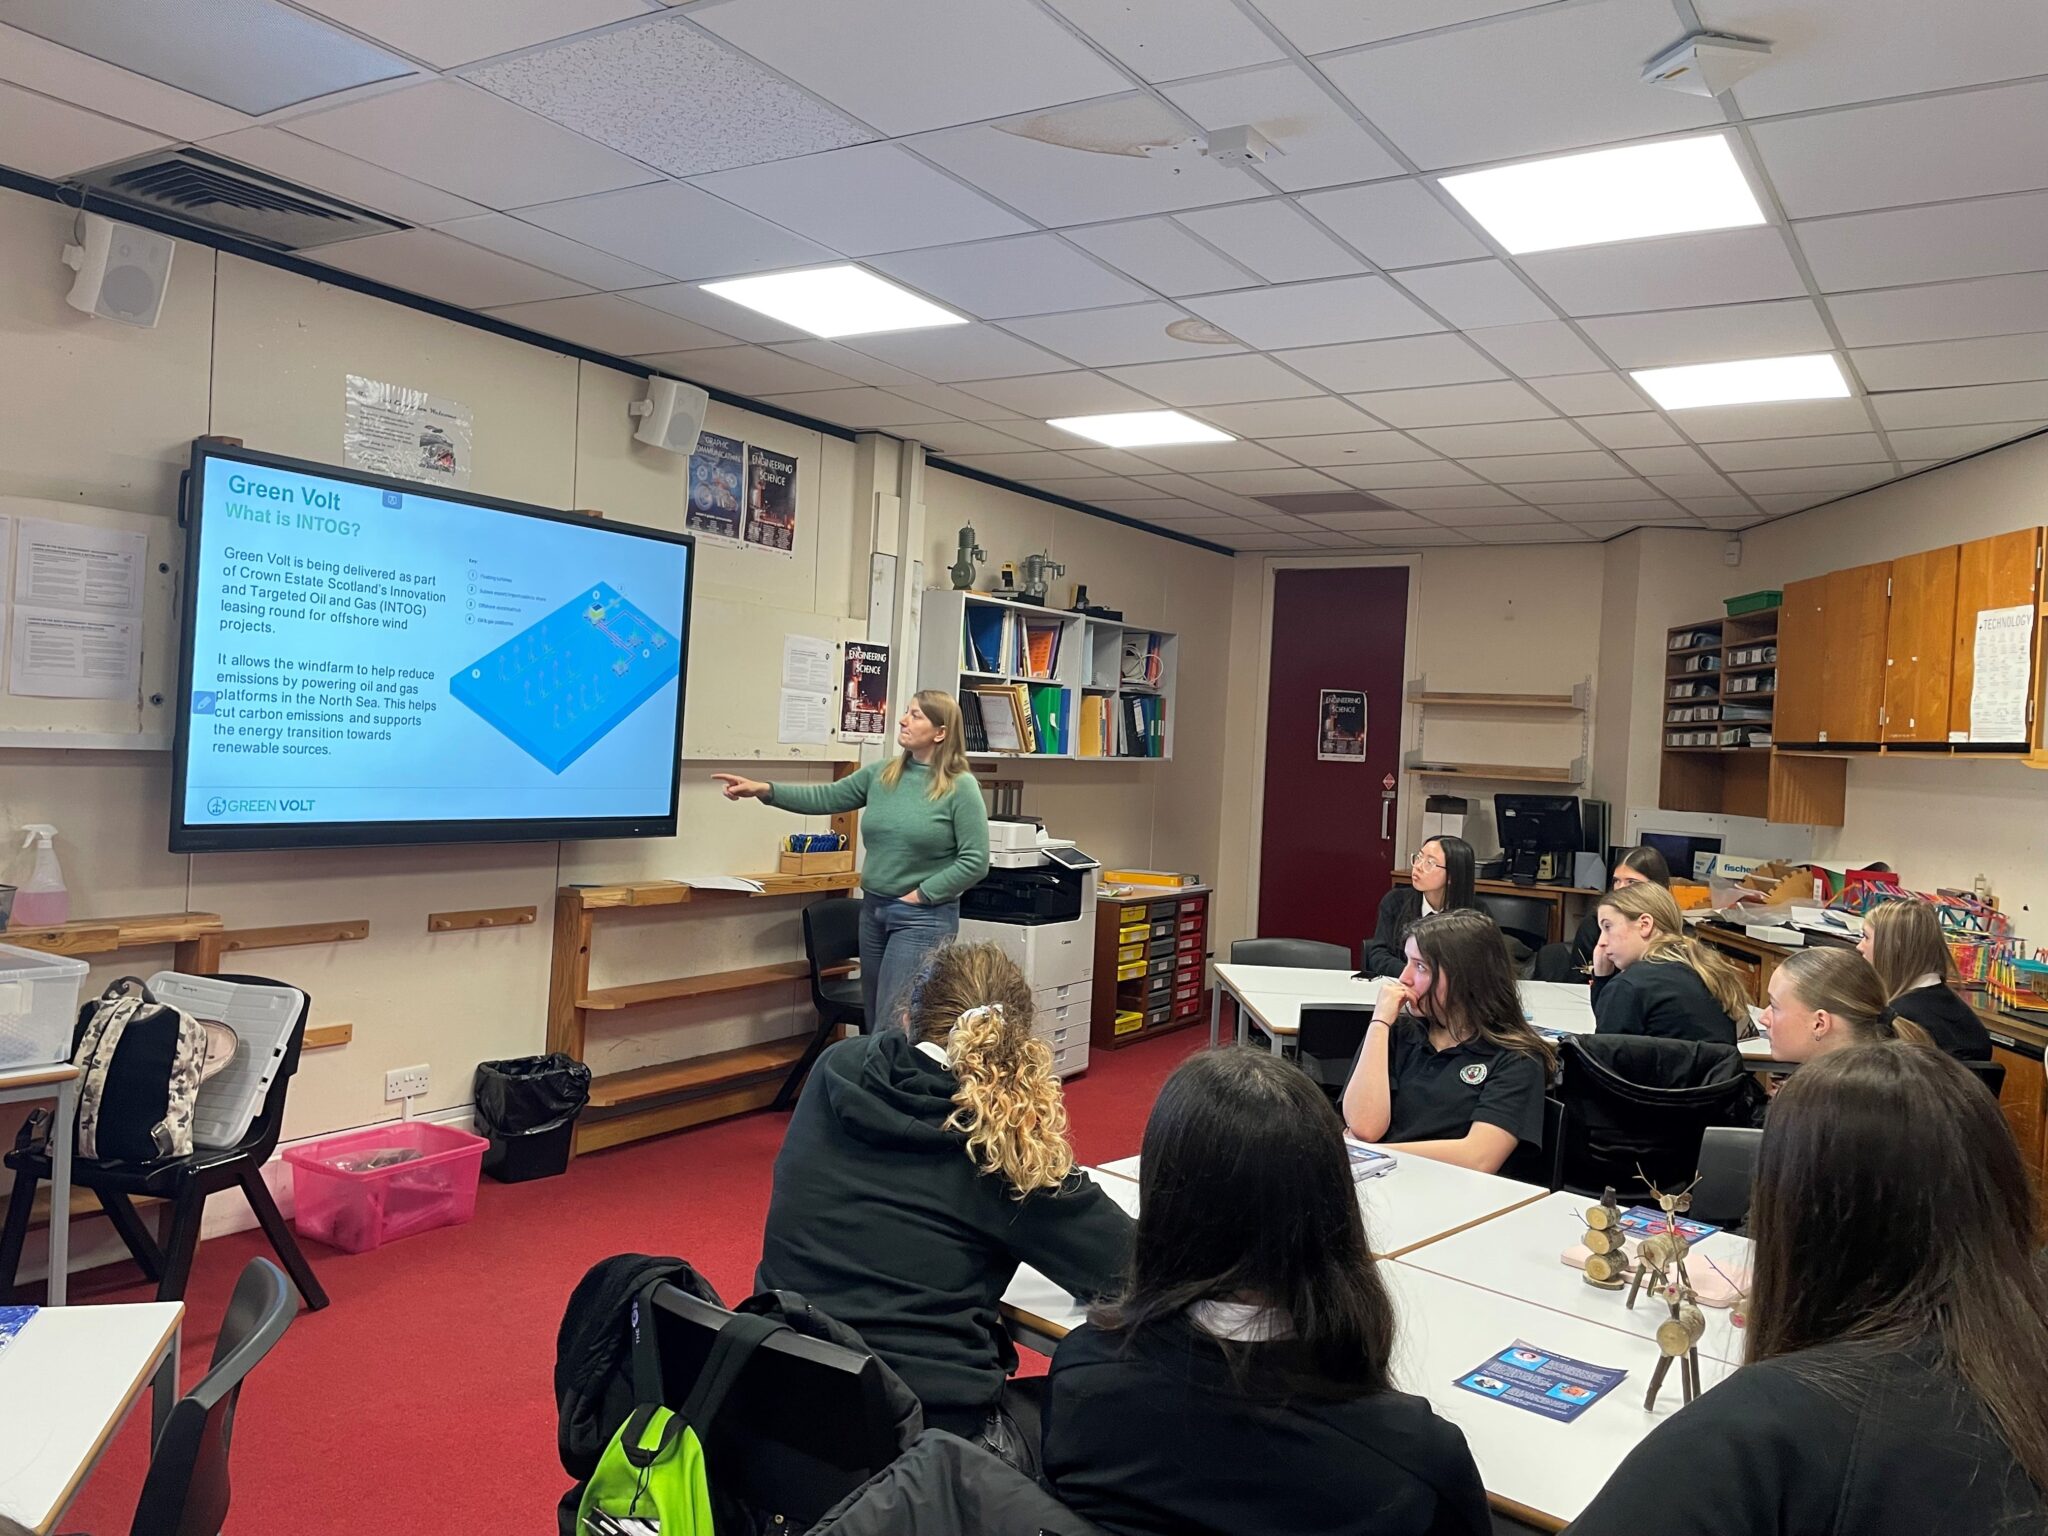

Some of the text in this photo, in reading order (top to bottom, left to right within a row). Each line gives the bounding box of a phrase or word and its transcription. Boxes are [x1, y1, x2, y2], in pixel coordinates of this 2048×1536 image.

[705, 436, 729, 449] GRAPHIC
[696, 444, 742, 462] OMMUNICATION
[752, 454, 793, 473] ENGINEERING
[760, 471, 786, 486] SCIENCE
[228, 474, 341, 511] Green Volt
[225, 502, 361, 537] What is INTOG?
[224, 546, 436, 587] Green Volt is being delivered as part
[222, 565, 446, 602] of Crown Estate Scotland's Innovation
[221, 582, 427, 618] and Targeted Oil and Gas (INTOG)
[220, 599, 408, 630] leasing round for offshore wind
[1984, 614, 2032, 630] TECHNOLOGY
[219, 618, 276, 634] projects.
[848, 649, 887, 663] ENGINEERING
[218, 653, 435, 680] It allows the windfarm to help reduce
[856, 664, 881, 675] SCIENCE
[216, 672, 419, 696] emissions by powering oil and gas
[215, 689, 437, 712] platforms in the North Sea. This helps
[214, 707, 422, 726] cut carbon emissions and supports
[213, 723, 392, 740] the energy transition towards
[212, 742, 332, 755] renewable sources.
[227, 799, 316, 812] GREEN VOLT
[1724, 863, 1754, 873] fische
